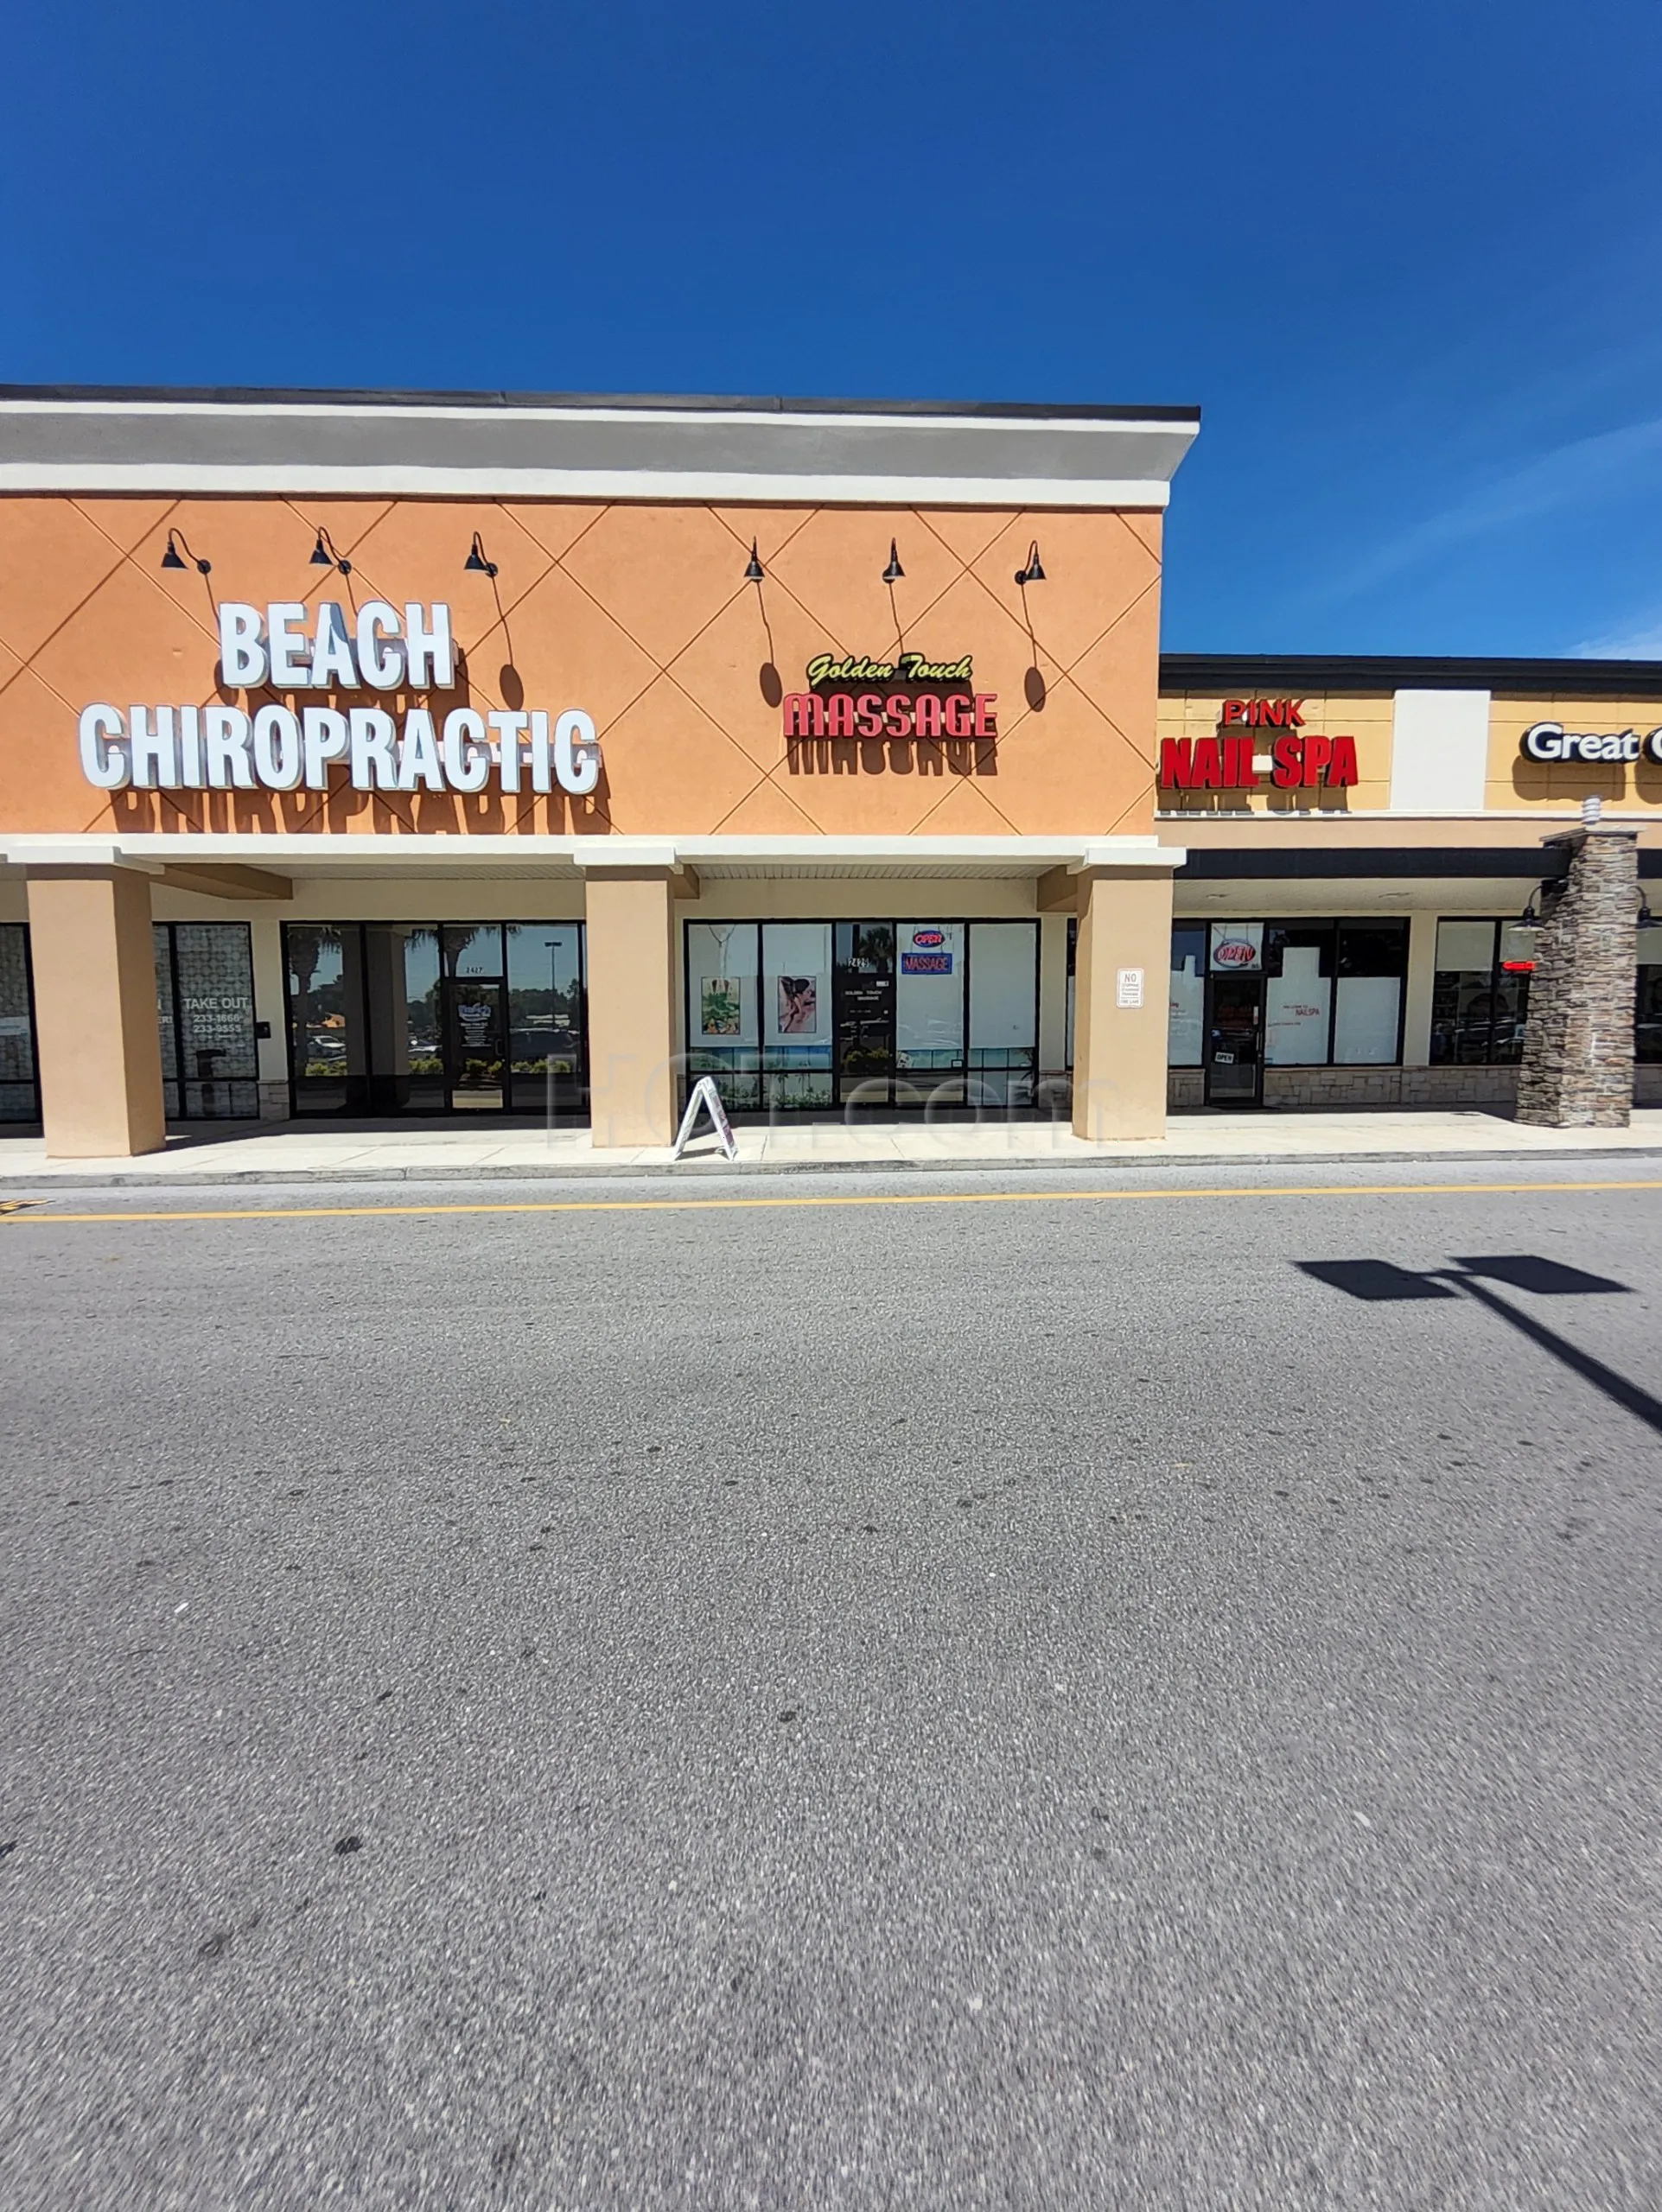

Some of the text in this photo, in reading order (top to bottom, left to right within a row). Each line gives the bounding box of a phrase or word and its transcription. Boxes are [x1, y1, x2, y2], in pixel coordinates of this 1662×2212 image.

[219, 601, 455, 690] BEACH
[806, 652, 973, 690] Golden Touch
[783, 693, 998, 738] MASSAGE
[1222, 698, 1306, 728] PINK
[80, 702, 601, 794] CHIROPRACTIC
[1524, 722, 1640, 762] Great
[1160, 734, 1359, 789] NAIL SPA
[915, 934, 942, 944] OPEN
[1218, 945, 1254, 962] OPEN
[905, 957, 948, 970] MASSAGE
[1124, 973, 1137, 982] NO
[183, 997, 248, 1009] TAKE OUT
[1216, 1052, 1233, 1062] OPEN
